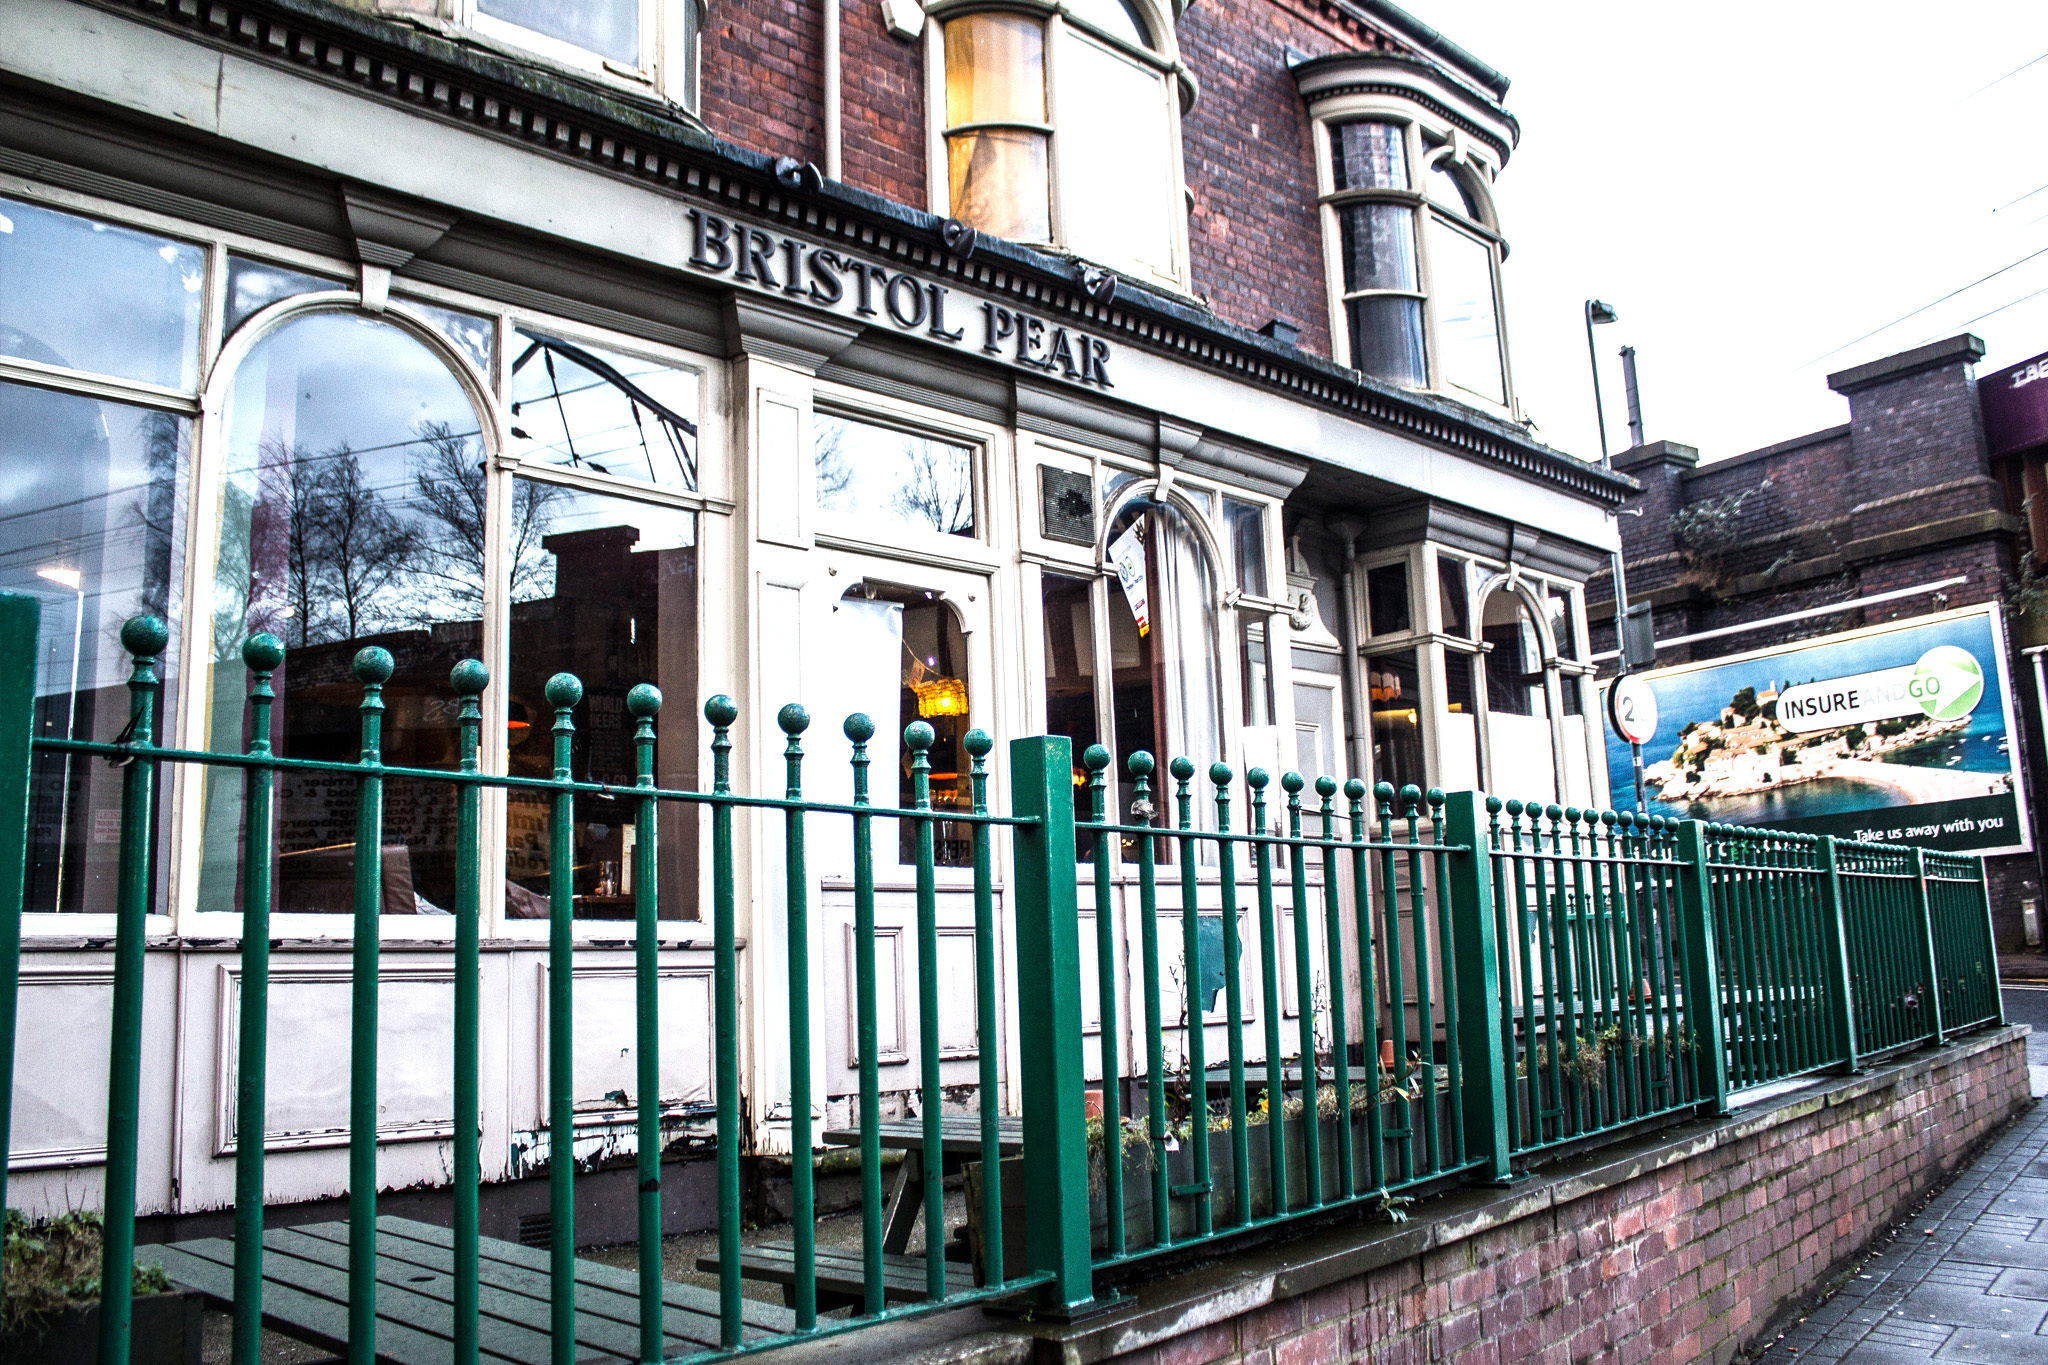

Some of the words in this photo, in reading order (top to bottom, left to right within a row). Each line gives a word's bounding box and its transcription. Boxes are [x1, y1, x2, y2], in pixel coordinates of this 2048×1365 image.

[686, 207, 964, 341] BRISTOL
[982, 301, 1115, 388] PEAR
[1853, 829, 1884, 843] Take
[1887, 827, 1903, 840] us
[1905, 824, 1940, 838] away
[1942, 818, 1974, 834] with
[1977, 817, 2004, 833] you
